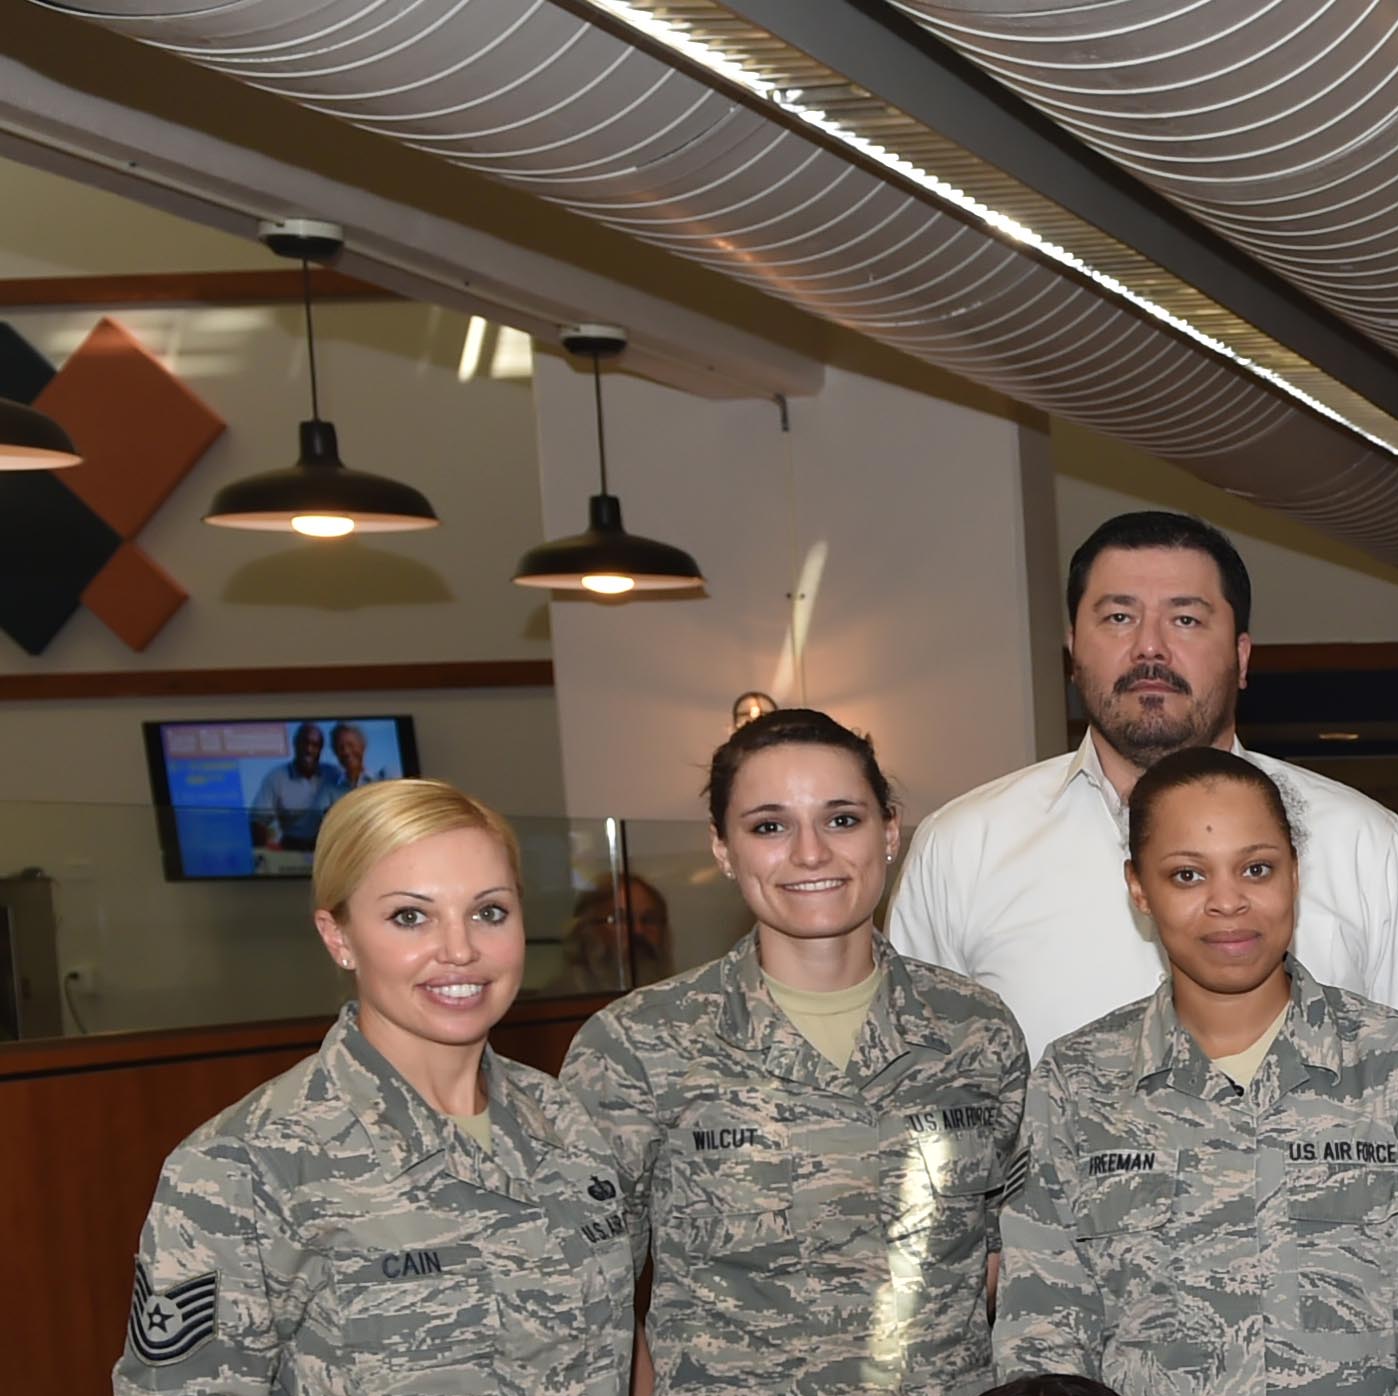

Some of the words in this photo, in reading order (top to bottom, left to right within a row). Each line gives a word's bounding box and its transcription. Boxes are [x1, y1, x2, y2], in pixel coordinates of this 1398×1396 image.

[692, 1127, 758, 1151] WILCUT
[1323, 1140, 1353, 1161] AIR
[1356, 1140, 1397, 1164] FORCE
[382, 1251, 442, 1278] CAIN
